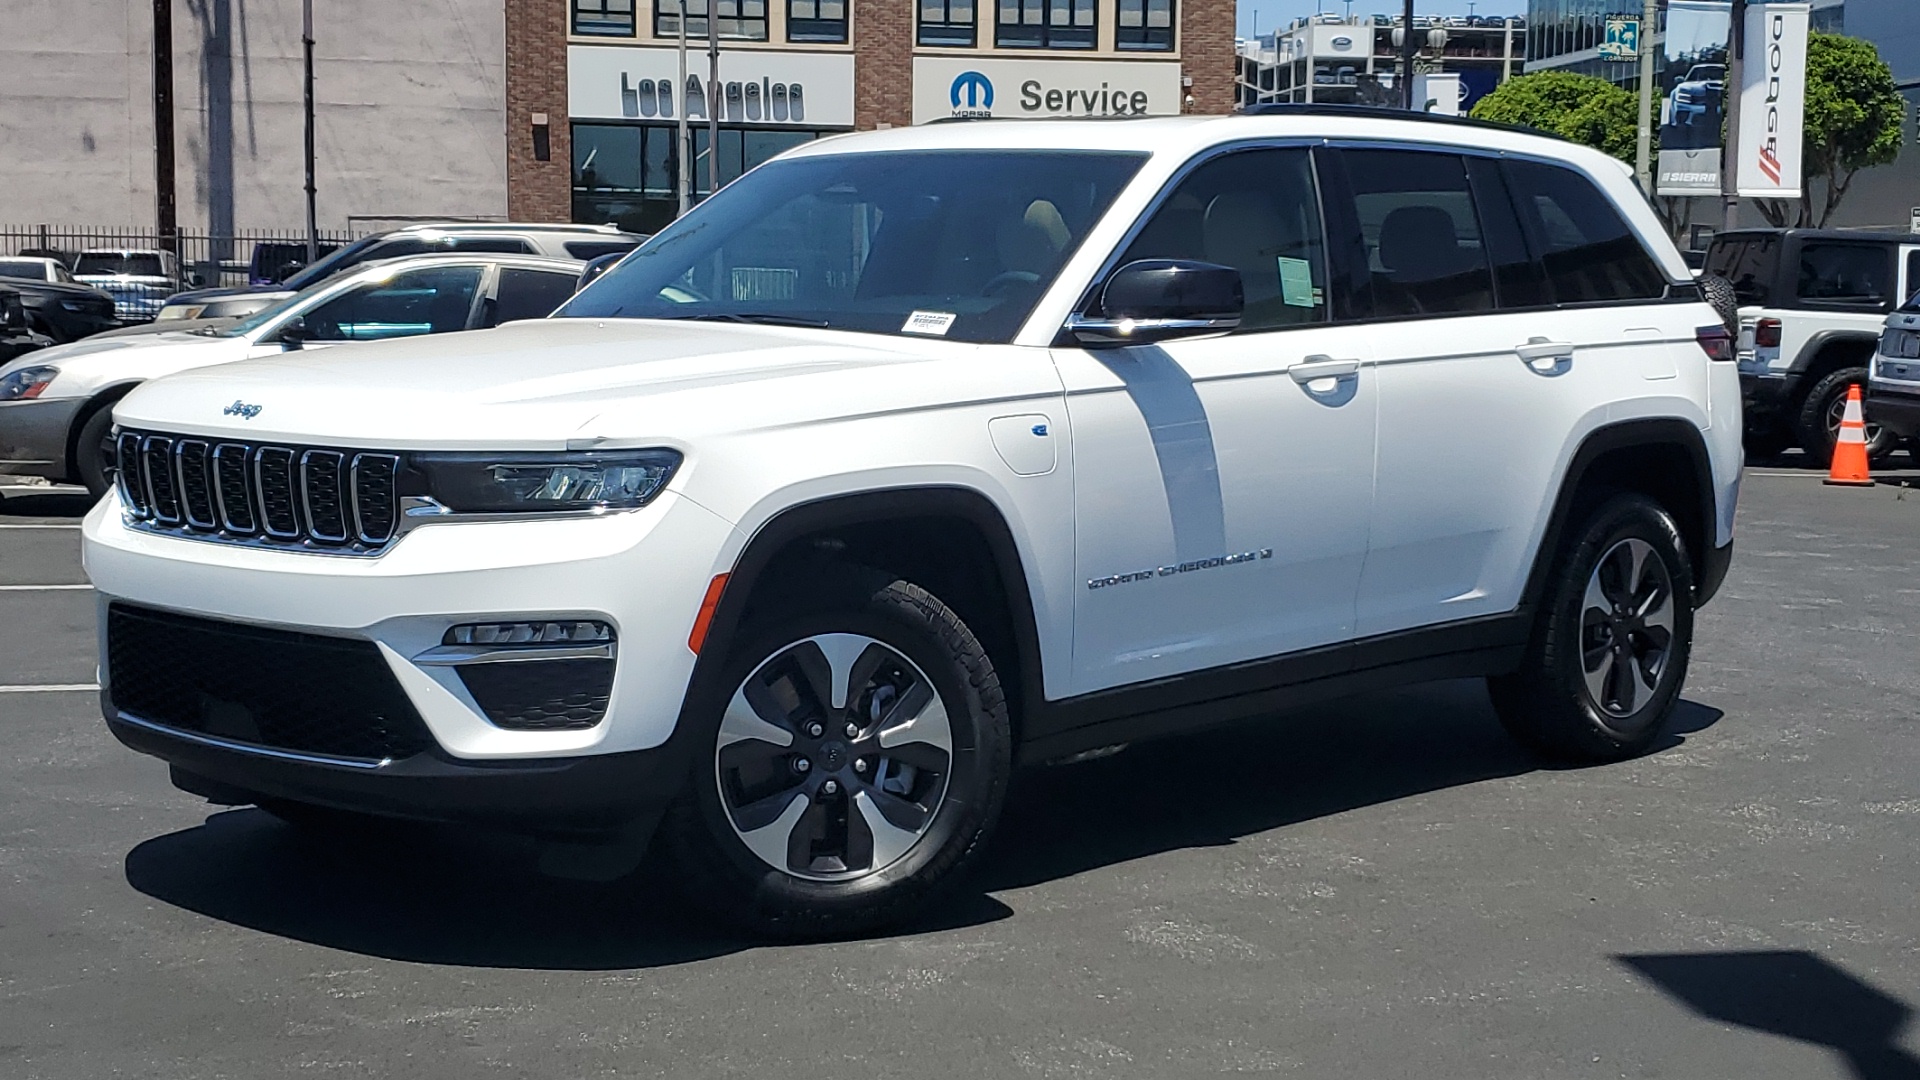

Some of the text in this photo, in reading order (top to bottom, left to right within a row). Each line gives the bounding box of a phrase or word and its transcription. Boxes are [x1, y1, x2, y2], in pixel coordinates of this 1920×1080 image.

[621, 71, 804, 104] Los Angeles
[1020, 79, 1148, 112] Service
[1764, 15, 1783, 160] DODGE
[1670, 172, 1717, 182] SIERRA
[223, 399, 263, 420] Jeep
[1158, 552, 1255, 577] CHEROKEE
